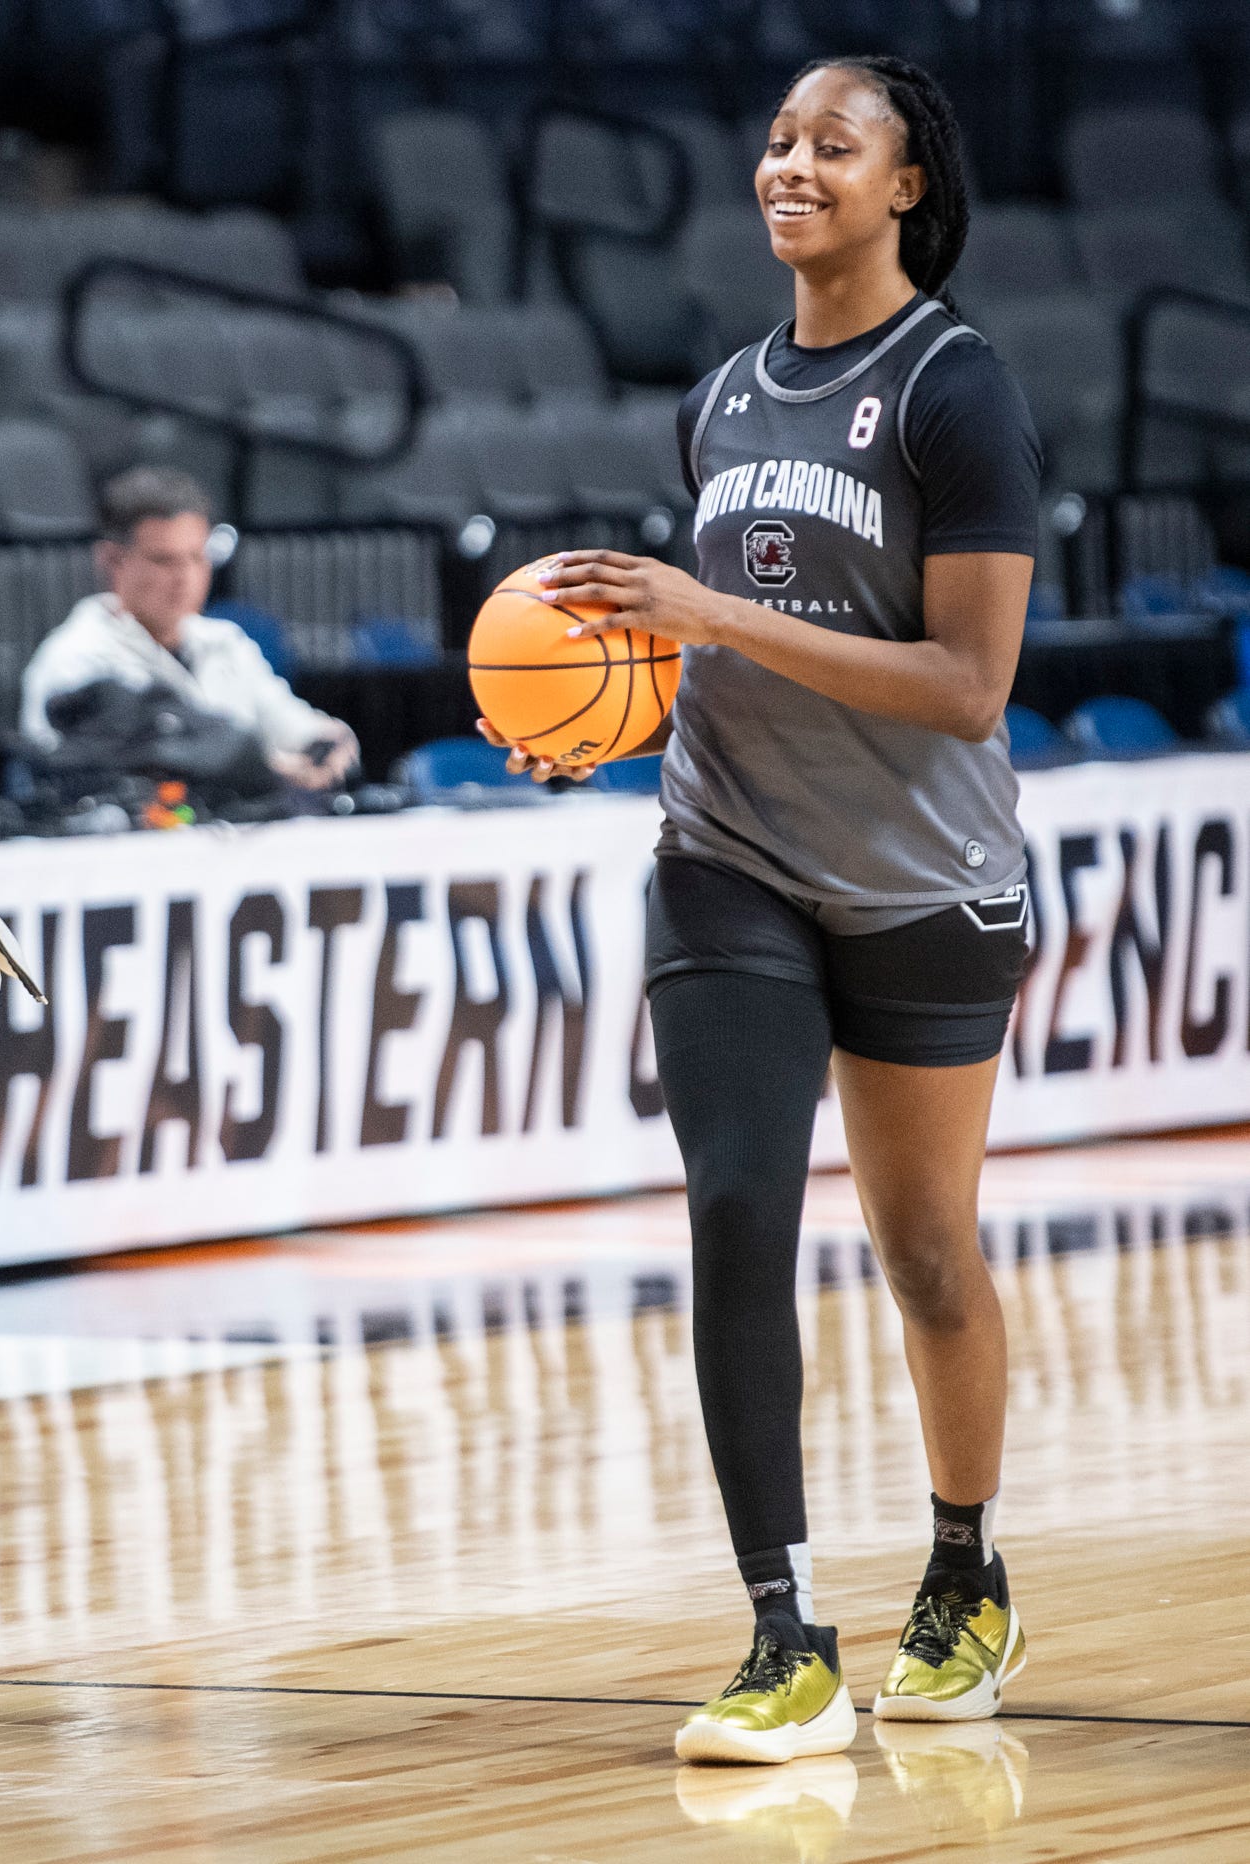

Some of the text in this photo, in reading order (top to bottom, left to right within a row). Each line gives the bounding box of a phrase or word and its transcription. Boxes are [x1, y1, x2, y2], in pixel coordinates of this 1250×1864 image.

[848, 396, 882, 449] 8
[752, 459, 884, 548] CAROLINA
[746, 598, 853, 613] ETBALL
